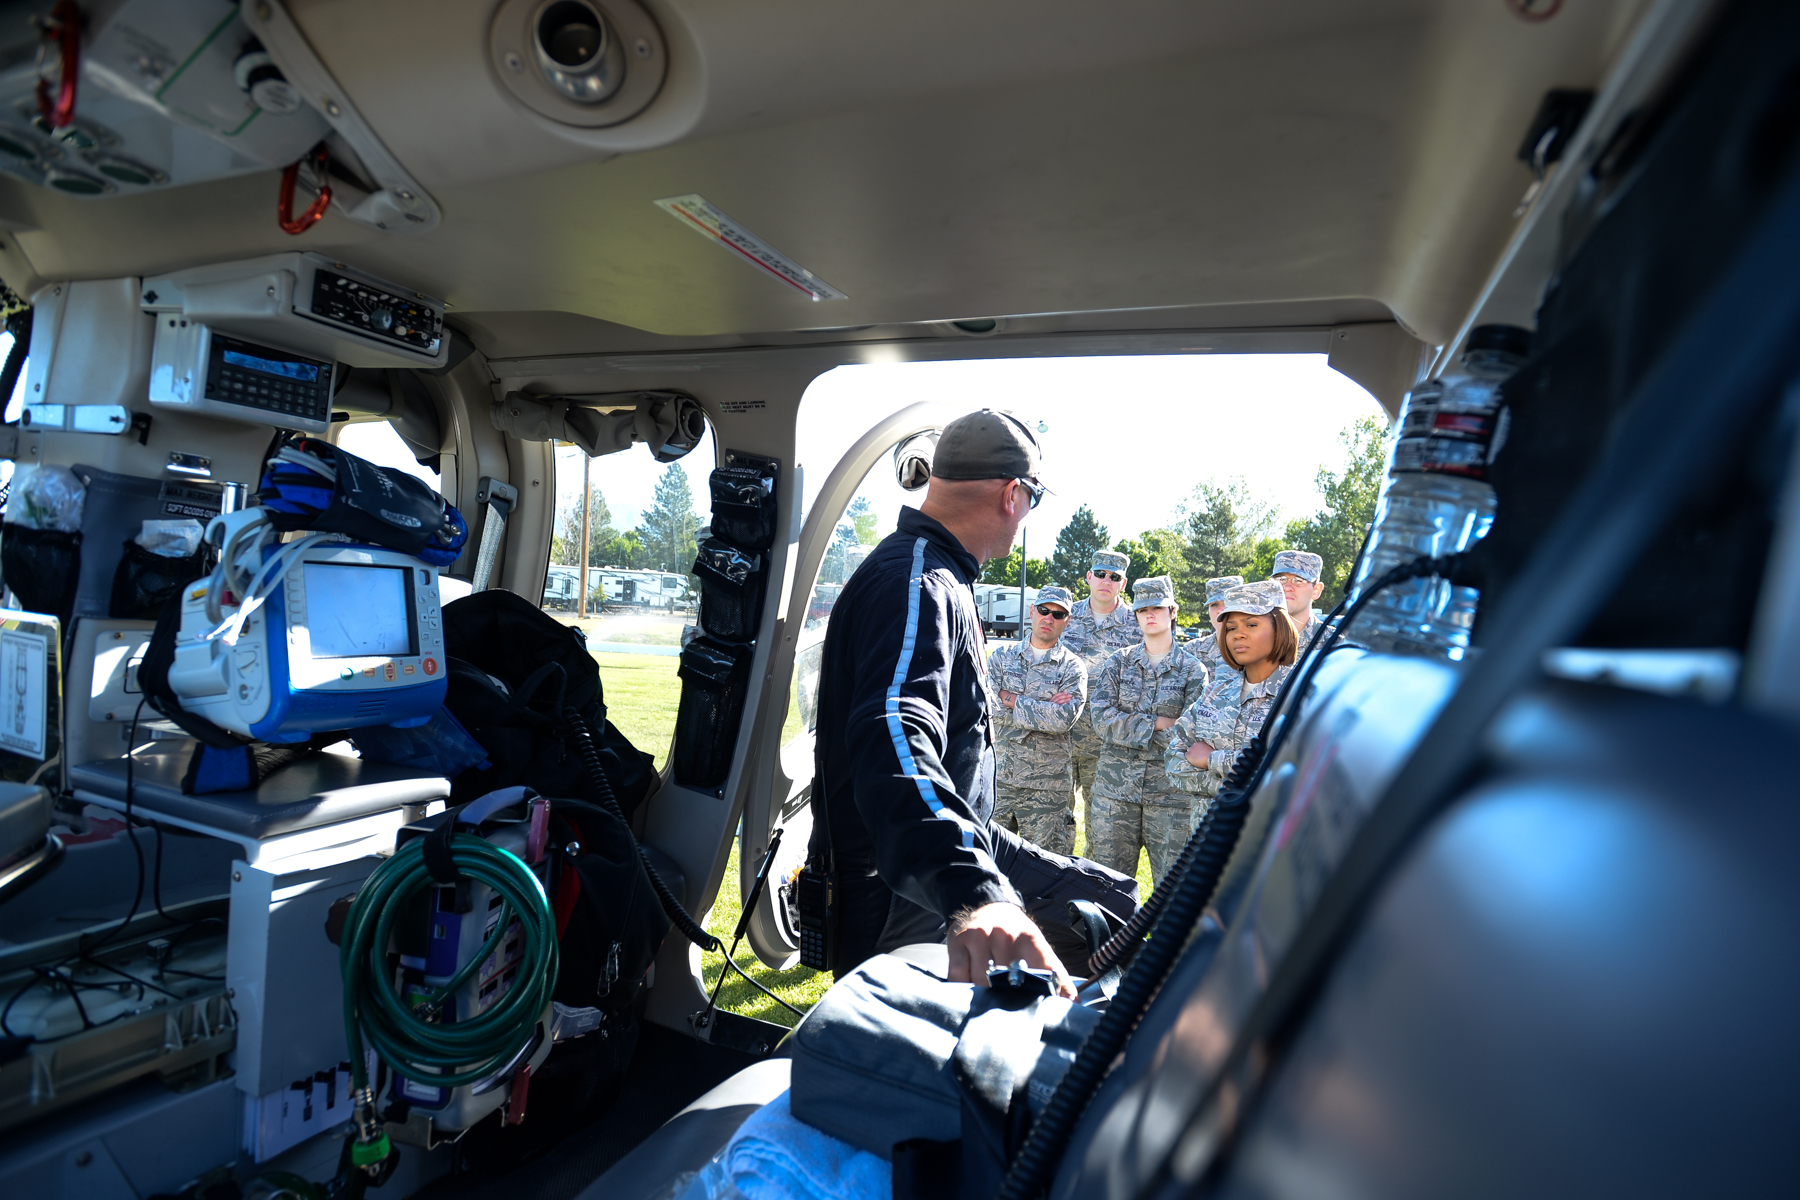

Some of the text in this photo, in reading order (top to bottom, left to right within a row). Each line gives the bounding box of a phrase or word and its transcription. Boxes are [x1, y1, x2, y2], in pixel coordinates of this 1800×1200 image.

[165, 486, 184, 497] MAX
[186, 490, 214, 502] WEIGHT
[167, 503, 184, 512] SOFT
[183, 506, 204, 516] GOODS
